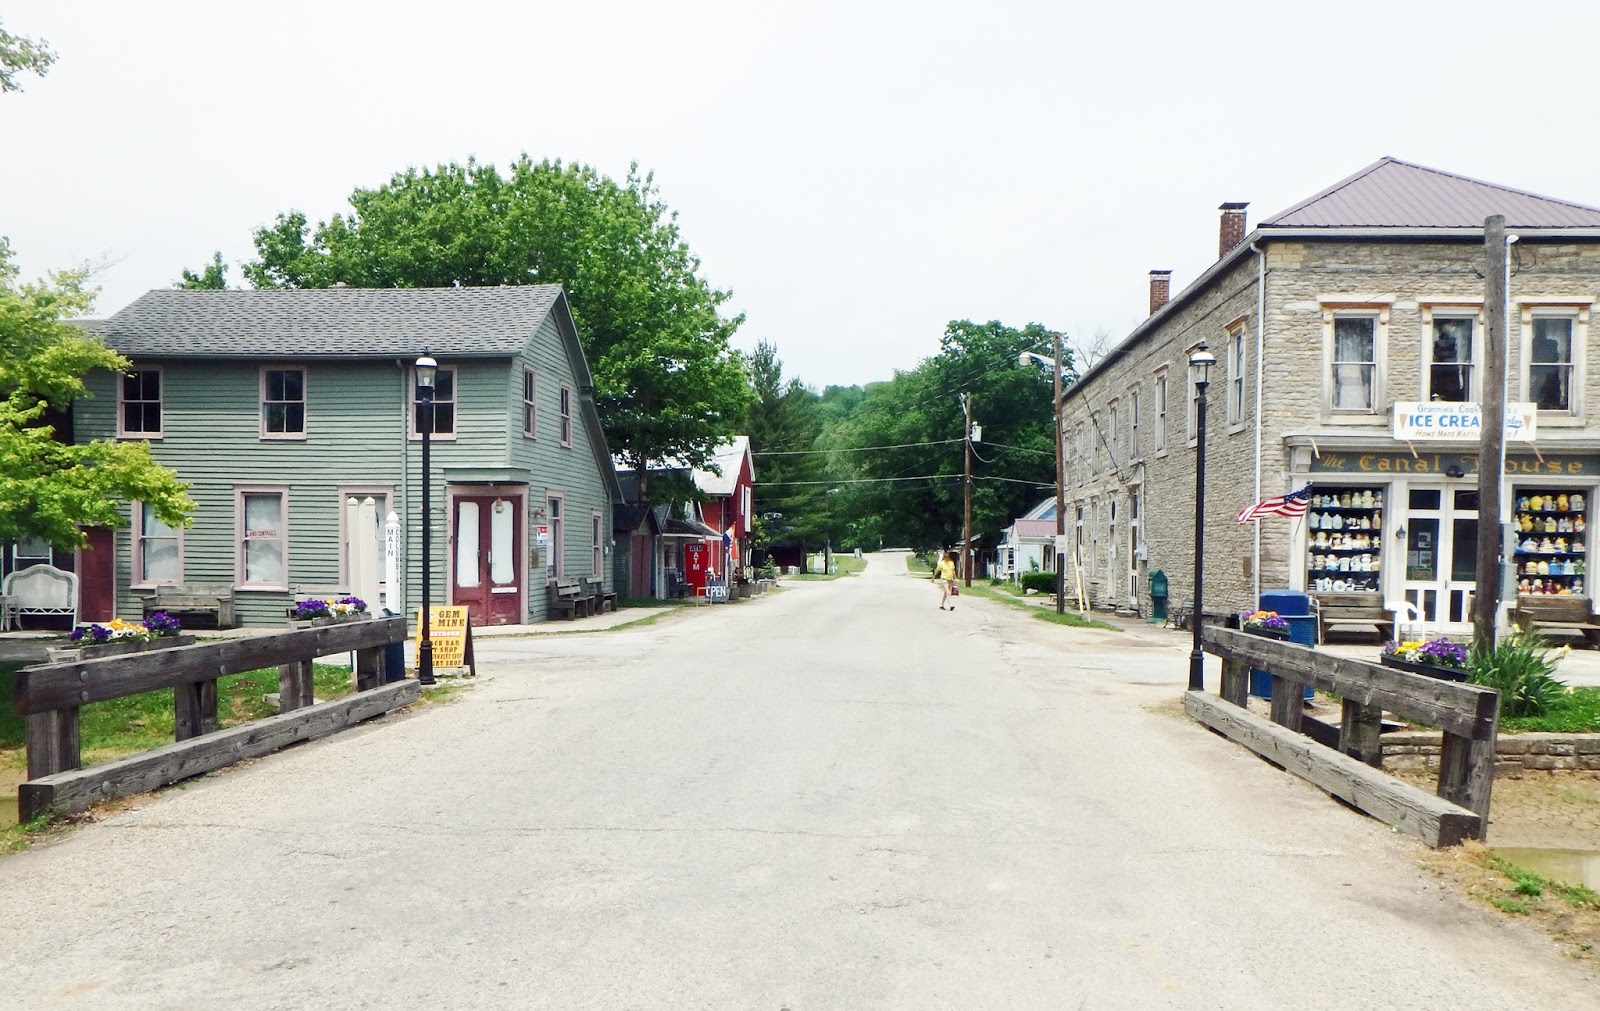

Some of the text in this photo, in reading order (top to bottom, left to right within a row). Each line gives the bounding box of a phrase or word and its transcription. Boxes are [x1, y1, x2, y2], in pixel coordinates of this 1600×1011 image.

[1458, 404, 1480, 413] Cook
[1409, 414, 1433, 427] ICE
[1438, 414, 1480, 427] CREA
[1322, 454, 1346, 468] The
[1358, 453, 1441, 472] Canal
[692, 552, 700, 570] ATM
[706, 586, 725, 597] OPEN
[439, 610, 461, 618] GEM
[438, 619, 465, 627] MINE
